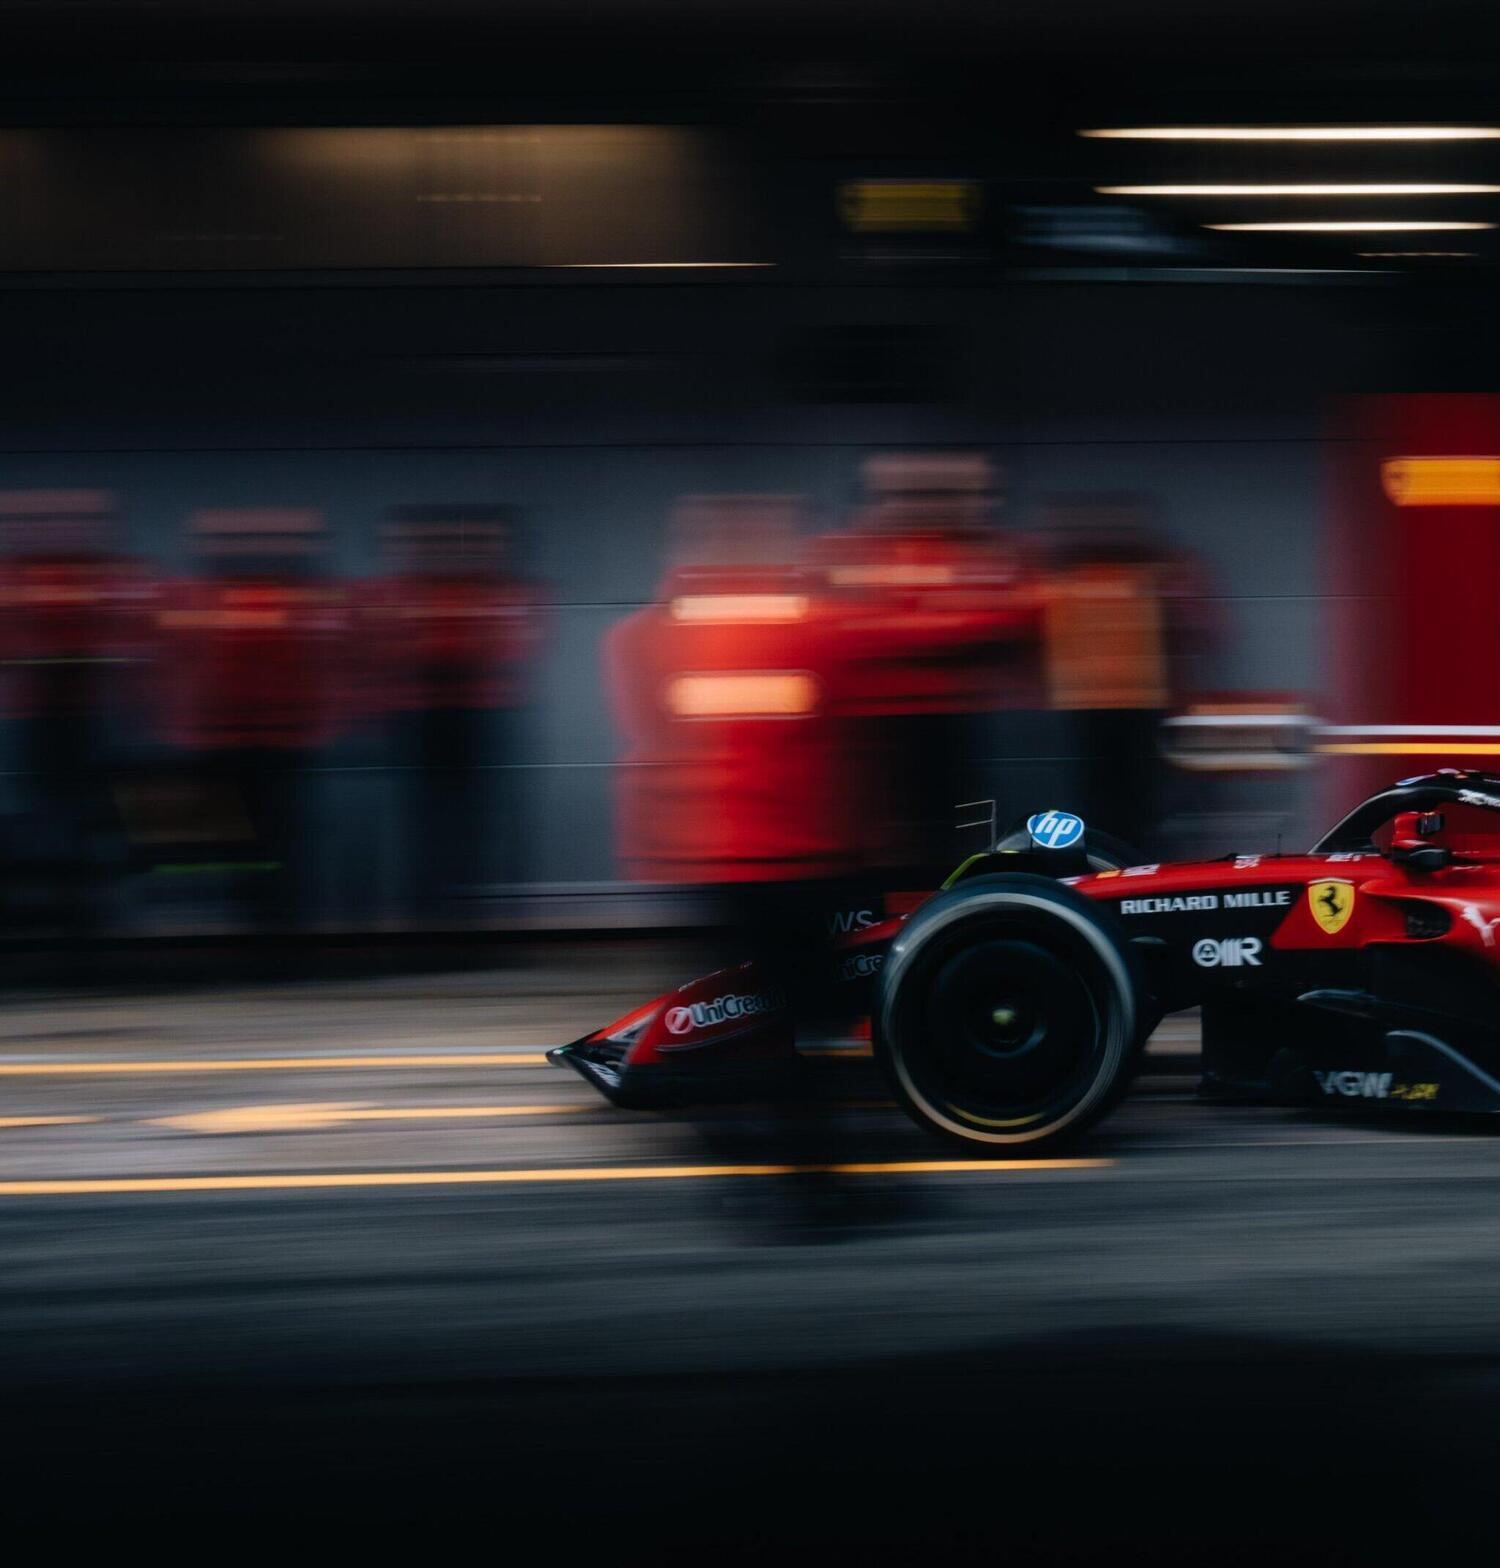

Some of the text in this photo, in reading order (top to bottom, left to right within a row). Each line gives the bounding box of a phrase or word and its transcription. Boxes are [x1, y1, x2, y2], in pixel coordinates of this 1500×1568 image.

[1036, 811, 1078, 848] hp
[1119, 889, 1292, 915] RICHARD MILLE
